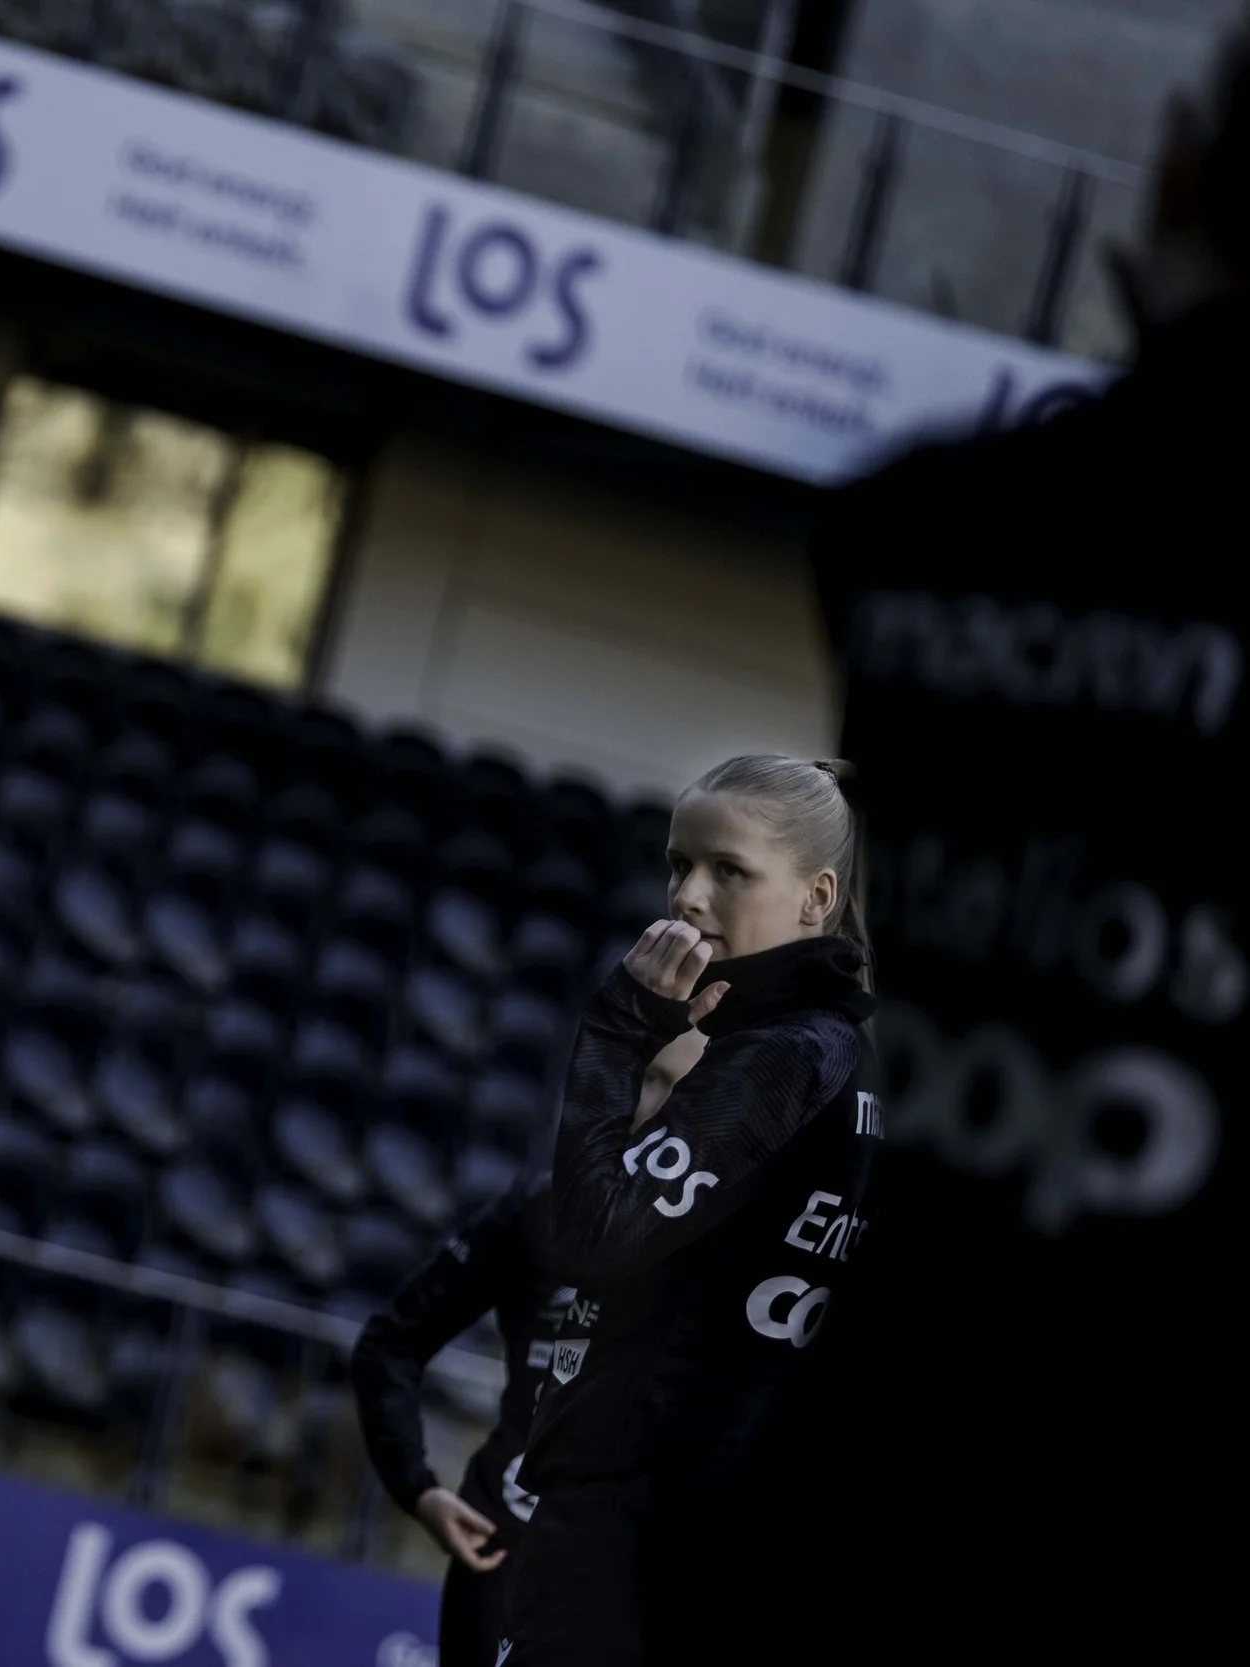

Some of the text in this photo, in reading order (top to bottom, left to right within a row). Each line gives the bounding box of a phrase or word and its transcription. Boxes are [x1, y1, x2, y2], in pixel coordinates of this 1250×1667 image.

[402, 204, 606, 372] LOS
[622, 1125, 720, 1217] LOS
[557, 1346, 579, 1375] HSH
